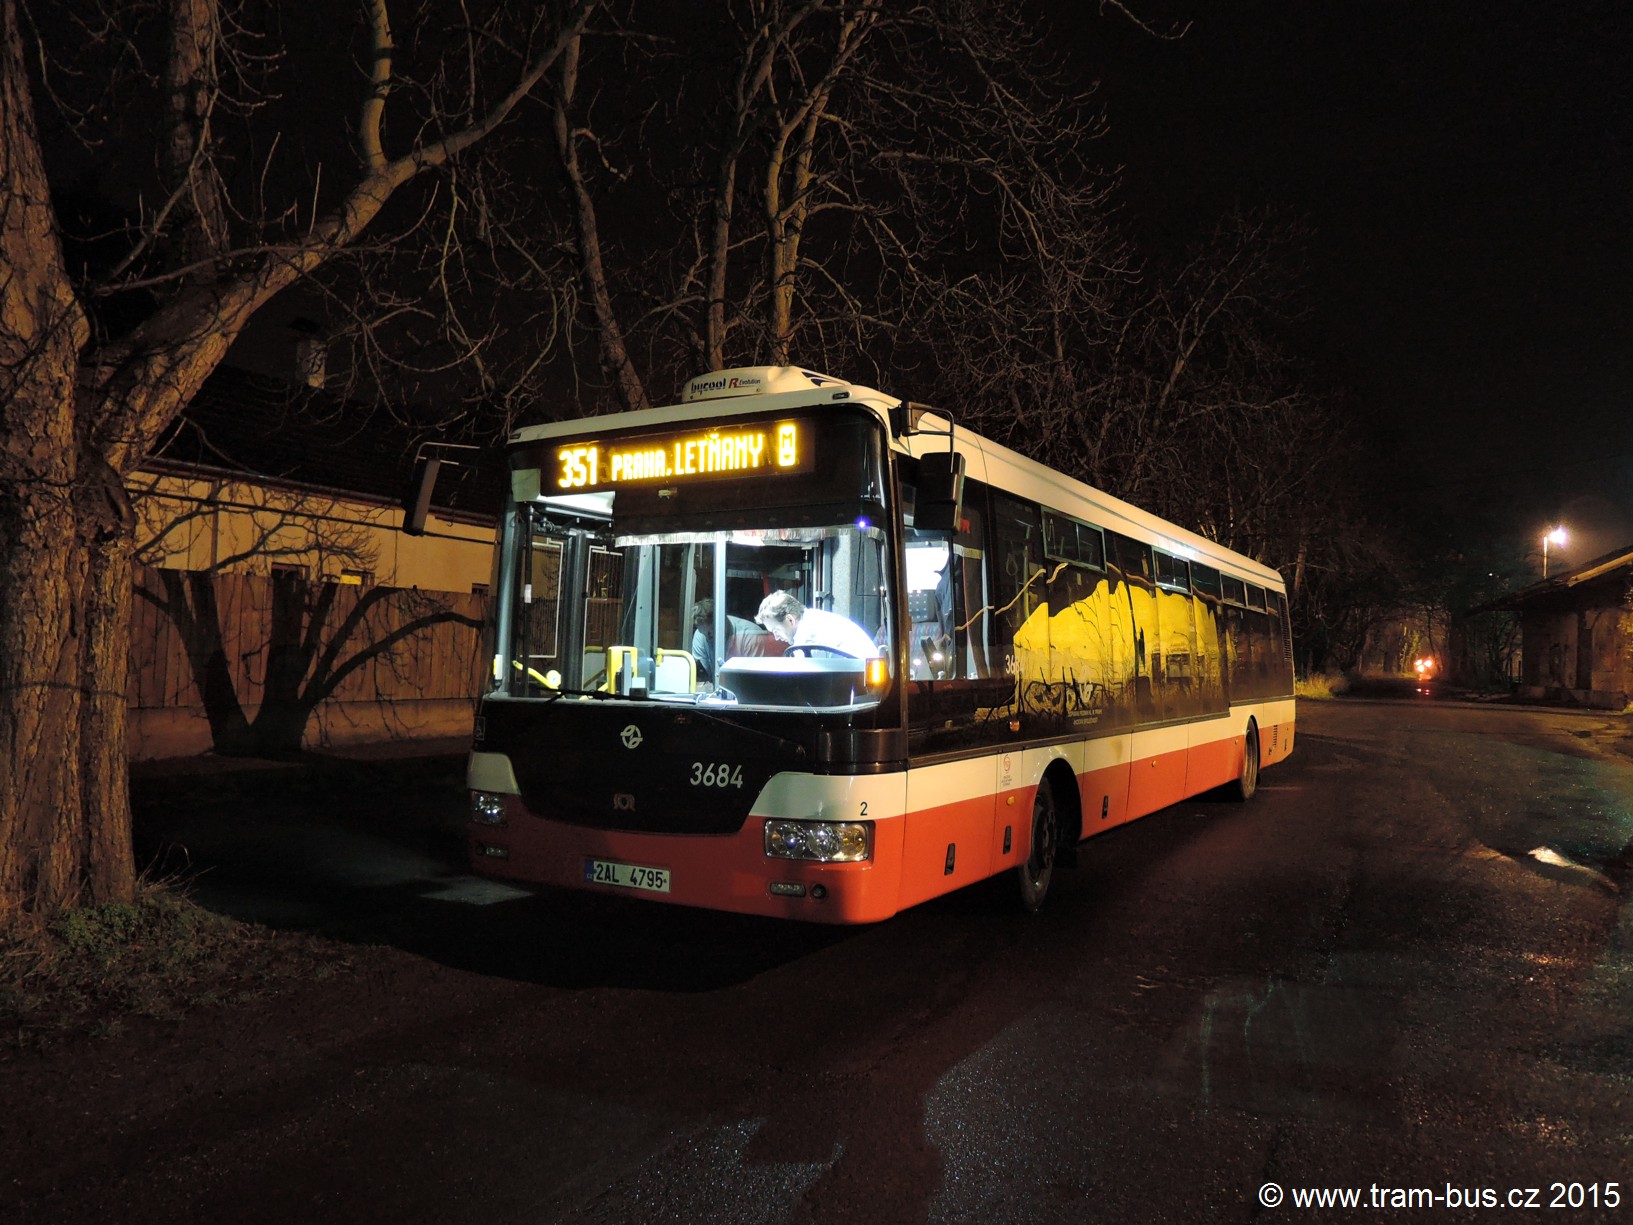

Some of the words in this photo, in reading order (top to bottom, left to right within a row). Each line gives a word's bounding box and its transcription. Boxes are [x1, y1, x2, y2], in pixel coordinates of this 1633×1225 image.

[690, 378, 727, 395] bycool
[558, 447, 598, 488] 351
[674, 433, 763, 475] LETŇANY
[690, 762, 743, 789] 3684
[860, 802, 868, 816] 2
[596, 863, 620, 883] 2AL
[629, 868, 664, 889] 4795
